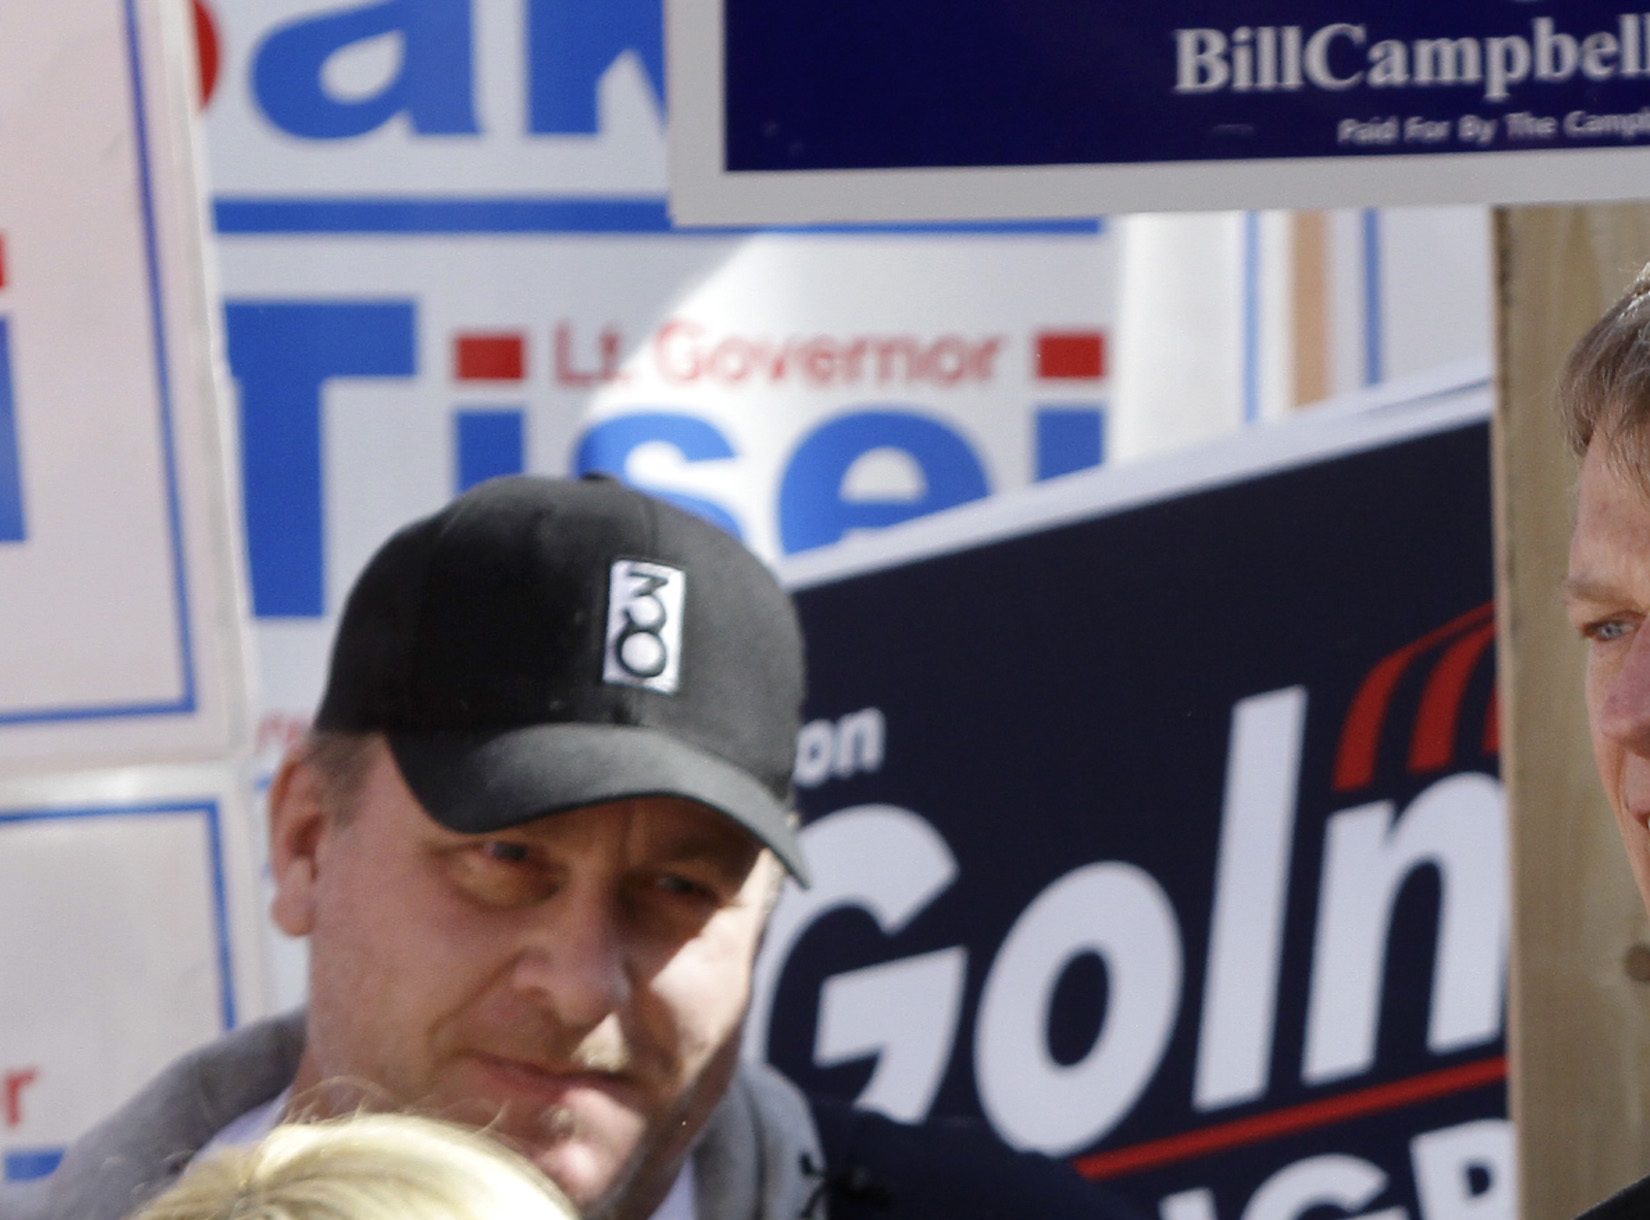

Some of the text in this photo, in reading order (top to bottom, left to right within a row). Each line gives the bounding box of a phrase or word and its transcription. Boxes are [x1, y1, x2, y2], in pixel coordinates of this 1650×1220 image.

[1336, 117, 1399, 145] Paid
[1403, 116, 1451, 143] For
[1457, 114, 1498, 145] By
[1505, 111, 1558, 140] The
[654, 315, 1004, 389] Governor
